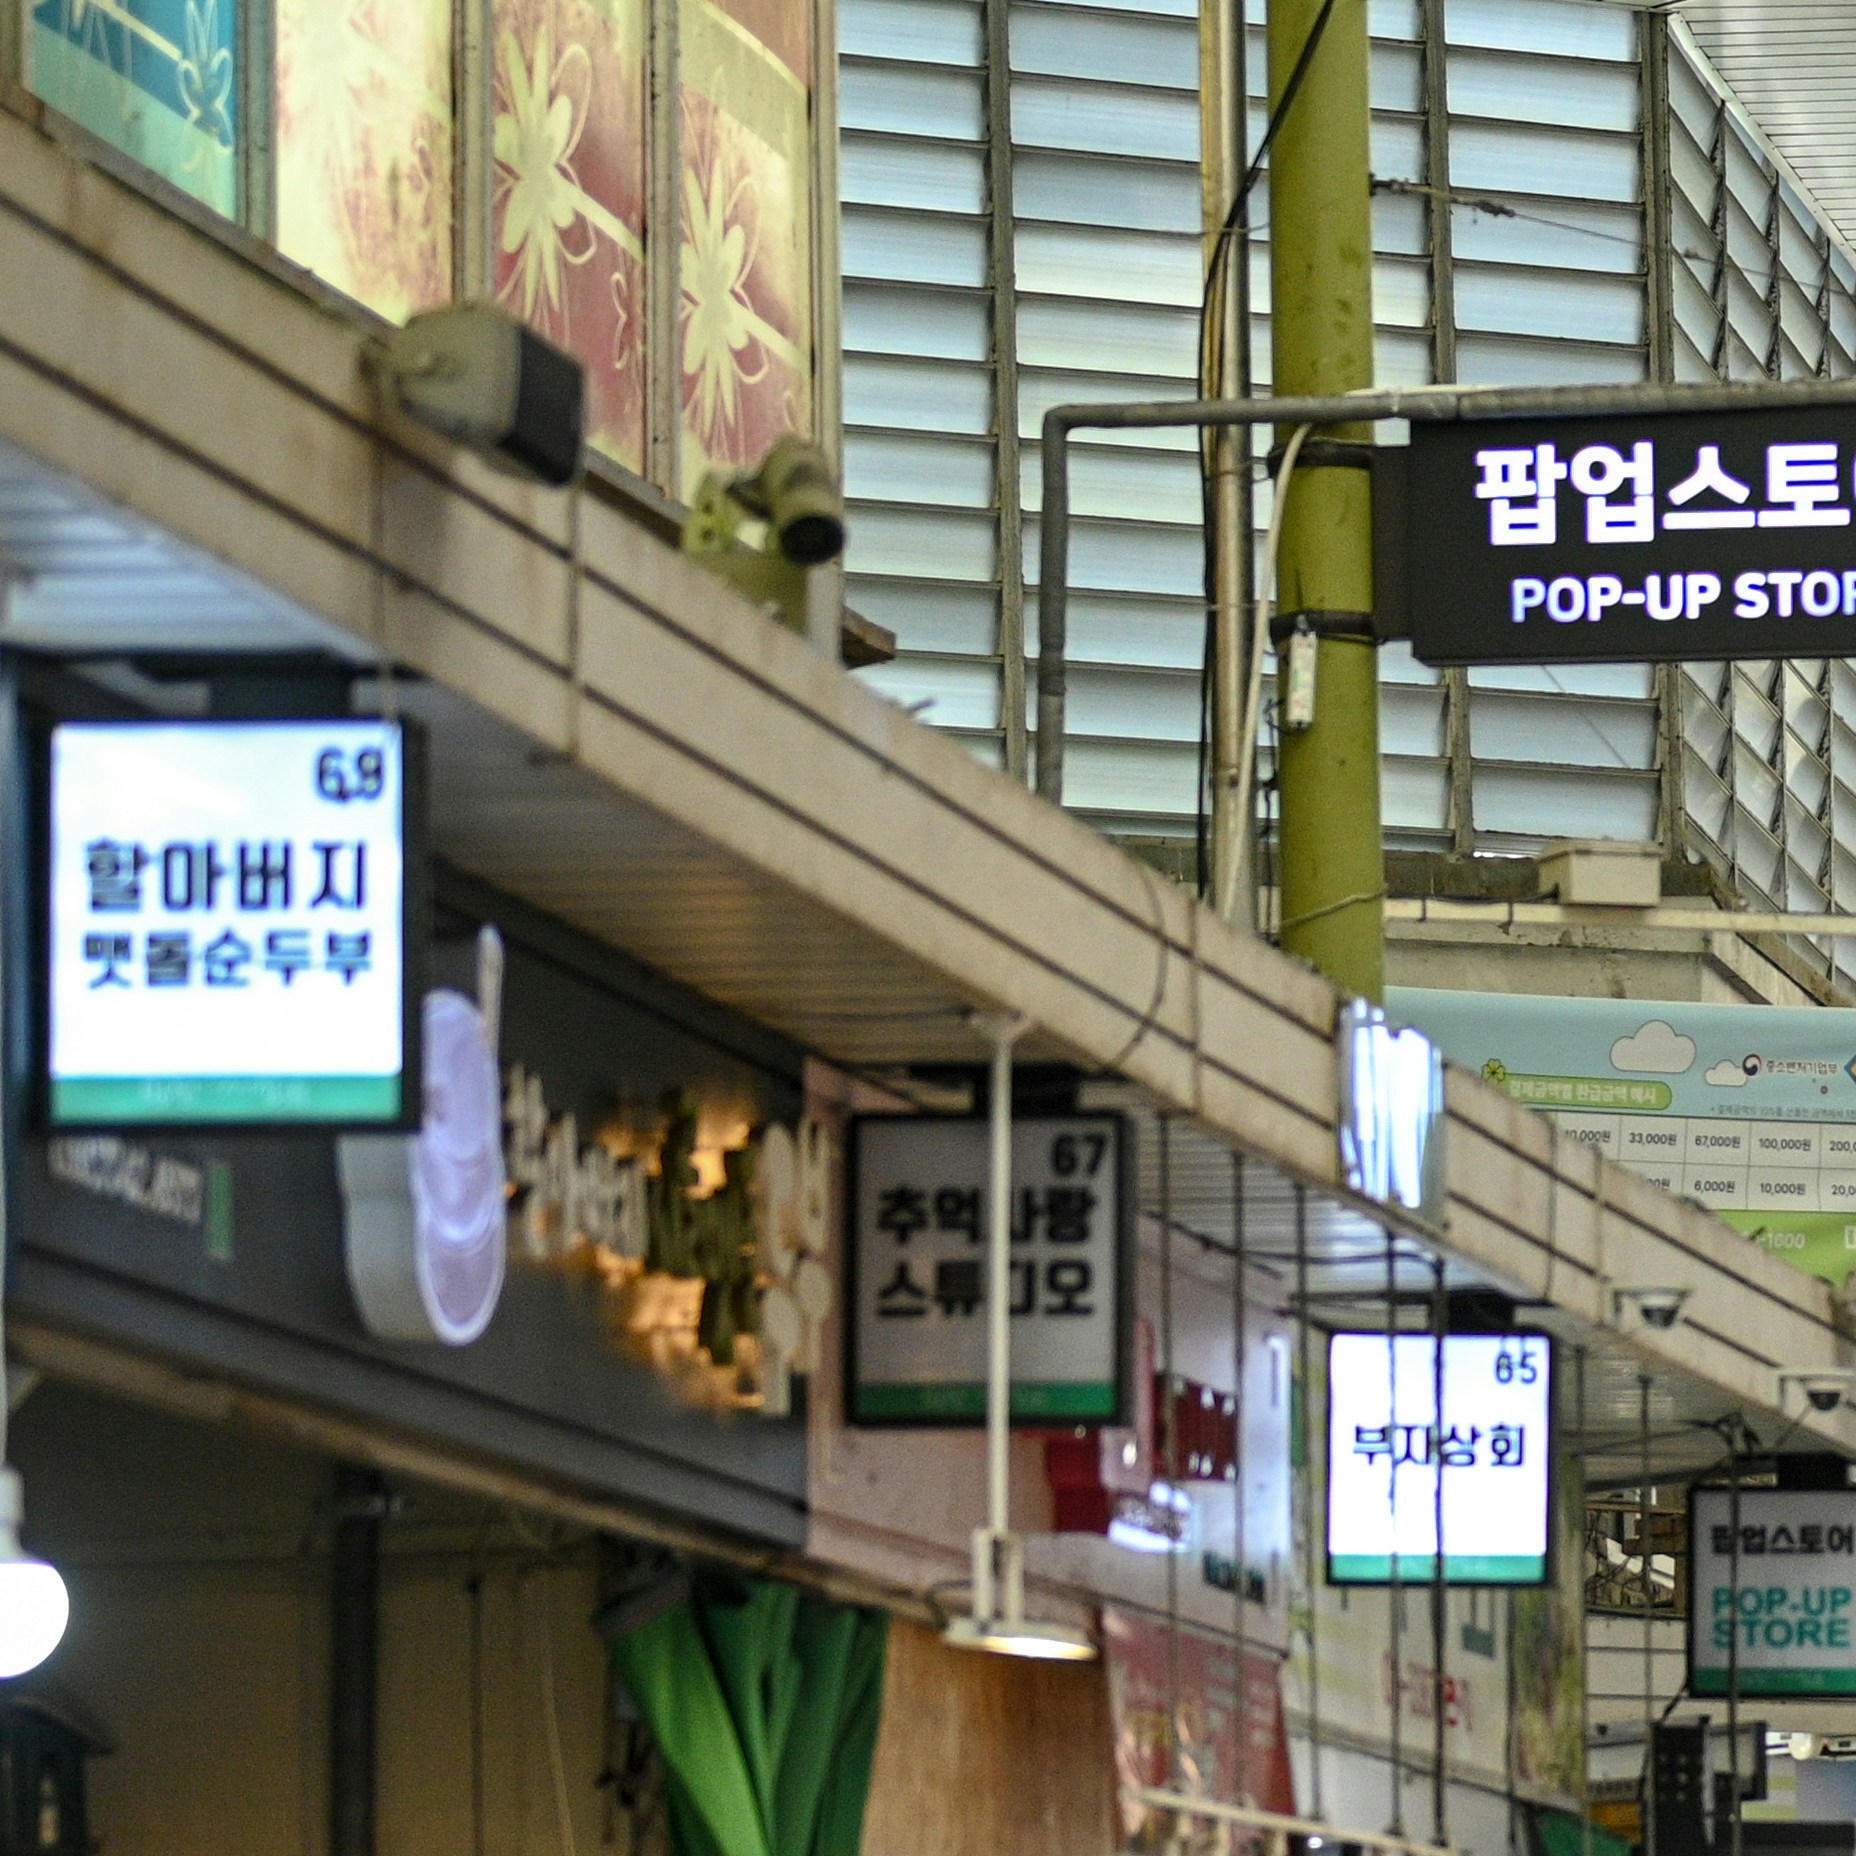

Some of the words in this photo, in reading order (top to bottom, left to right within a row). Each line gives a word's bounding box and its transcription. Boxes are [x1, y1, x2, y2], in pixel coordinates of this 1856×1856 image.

[1512, 573, 1719, 623] POP-UP
[315, 748, 386, 801] 69
[84, 838, 369, 914] 할아버지
[1629, 1132, 1677, 1145] 33,000원
[1694, 1134, 1741, 1148] 67,000원
[1759, 1137, 1811, 1151] 100,000원
[1054, 1134, 1104, 1176] 67
[1694, 1180, 1735, 1193] 6,000원
[1760, 1183, 1806, 1195] 10,000원
[877, 1262, 1093, 1317] 스튜디오
[1496, 1353, 1538, 1384] 65
[1352, 1424, 1526, 1468] 부자상회
[1712, 1525, 1855, 1556] 팝업스토어
[1713, 1587, 1853, 1616] POP-UP
[1713, 1619, 1850, 1648] STORE
